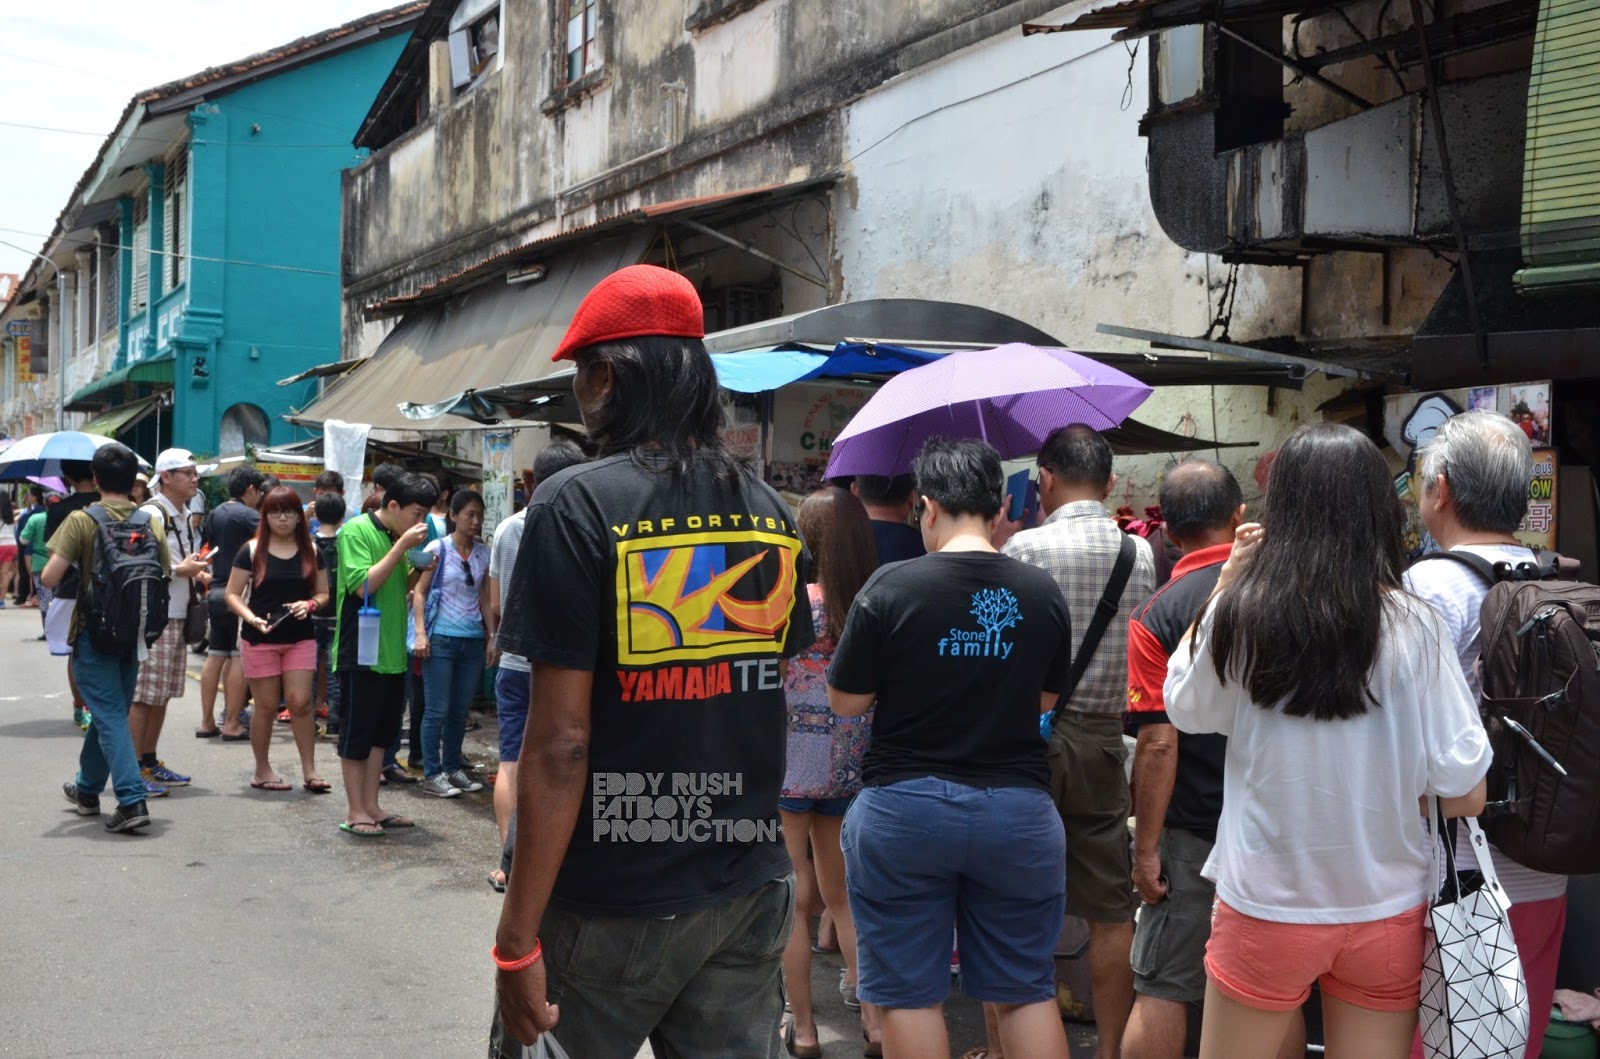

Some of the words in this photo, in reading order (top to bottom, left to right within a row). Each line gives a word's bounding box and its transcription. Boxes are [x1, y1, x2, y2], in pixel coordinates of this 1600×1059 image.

[800, 431, 833, 451] CH
[1528, 478, 1553, 500] OW
[1519, 503, 1553, 533] 哥
[949, 628, 986, 641] Stone
[937, 638, 1014, 660] family
[617, 661, 732, 702] YAMAHA
